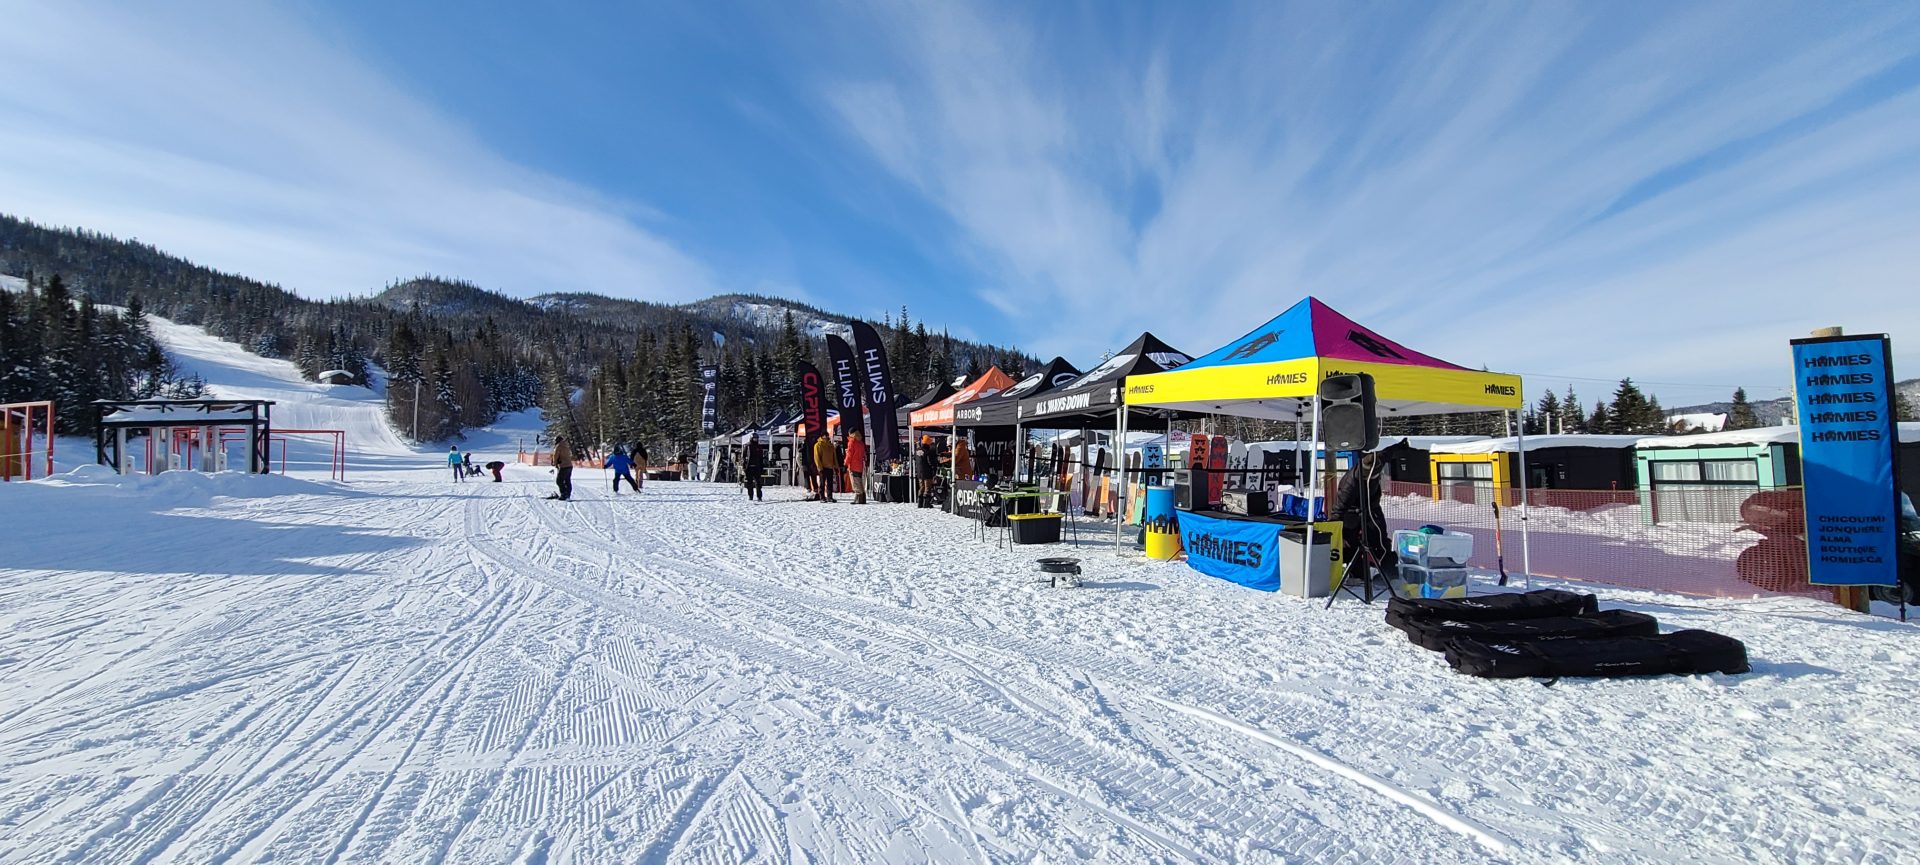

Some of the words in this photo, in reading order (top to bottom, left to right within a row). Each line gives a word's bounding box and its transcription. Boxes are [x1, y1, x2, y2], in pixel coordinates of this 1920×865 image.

[1804, 354, 1872, 368] HOMIES
[864, 348, 887, 404] SMITH
[1266, 372, 1308, 386] HOMIES
[1807, 373, 1873, 386] HOMIES
[836, 359, 856, 408] SMITH
[1128, 384, 1154, 395] HOMIES
[1484, 383, 1516, 396] HOMIES
[803, 372, 821, 433] CAPITA
[1808, 392, 1876, 405] HOMIES
[956, 409, 976, 420] ARBOR
[1810, 410, 1878, 424] HOMIES
[1812, 429, 1880, 442] HOMIES
[1188, 531, 1262, 568] HOMIES
